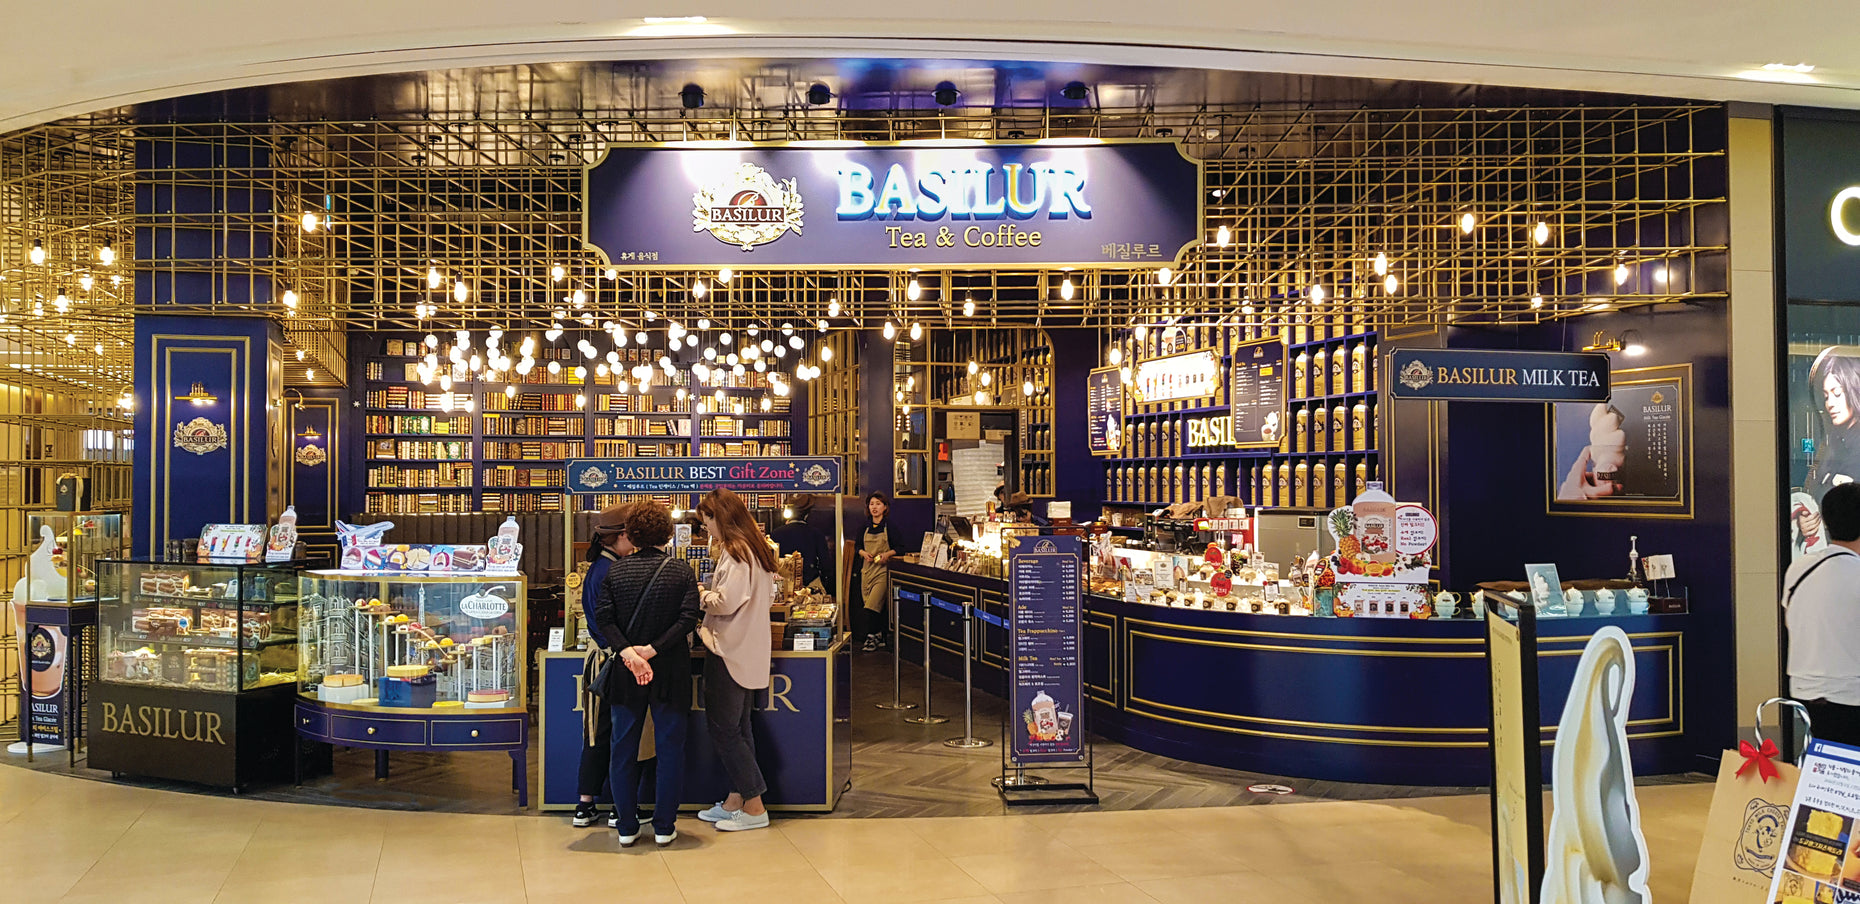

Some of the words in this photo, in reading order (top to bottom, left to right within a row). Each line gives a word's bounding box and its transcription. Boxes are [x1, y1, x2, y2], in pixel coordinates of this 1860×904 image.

[836, 162, 1093, 222] BASILUR
[711, 208, 784, 222] BASILUR
[885, 226, 928, 248] Tea
[936, 226, 955, 248] &
[963, 224, 1042, 248] Coffee
[620, 252, 636, 261] 휴게
[637, 252, 659, 261] 음식점
[1101, 243, 1163, 259] 베질루르
[1437, 367, 1519, 385] BASILUR
[1522, 369, 1565, 386] MILK
[1568, 370, 1601, 387] TEA
[1642, 404, 1672, 414] BASILUR
[183, 435, 219, 444] BASILUR
[1187, 415, 1233, 448] BASIL
[616, 467, 685, 480] BASILUR
[690, 466, 726, 479] BEST
[729, 463, 755, 480] Gift
[760, 466, 795, 479] Zone
[32, 703, 59, 714] ASILUR
[101, 702, 226, 745] BASILUR
